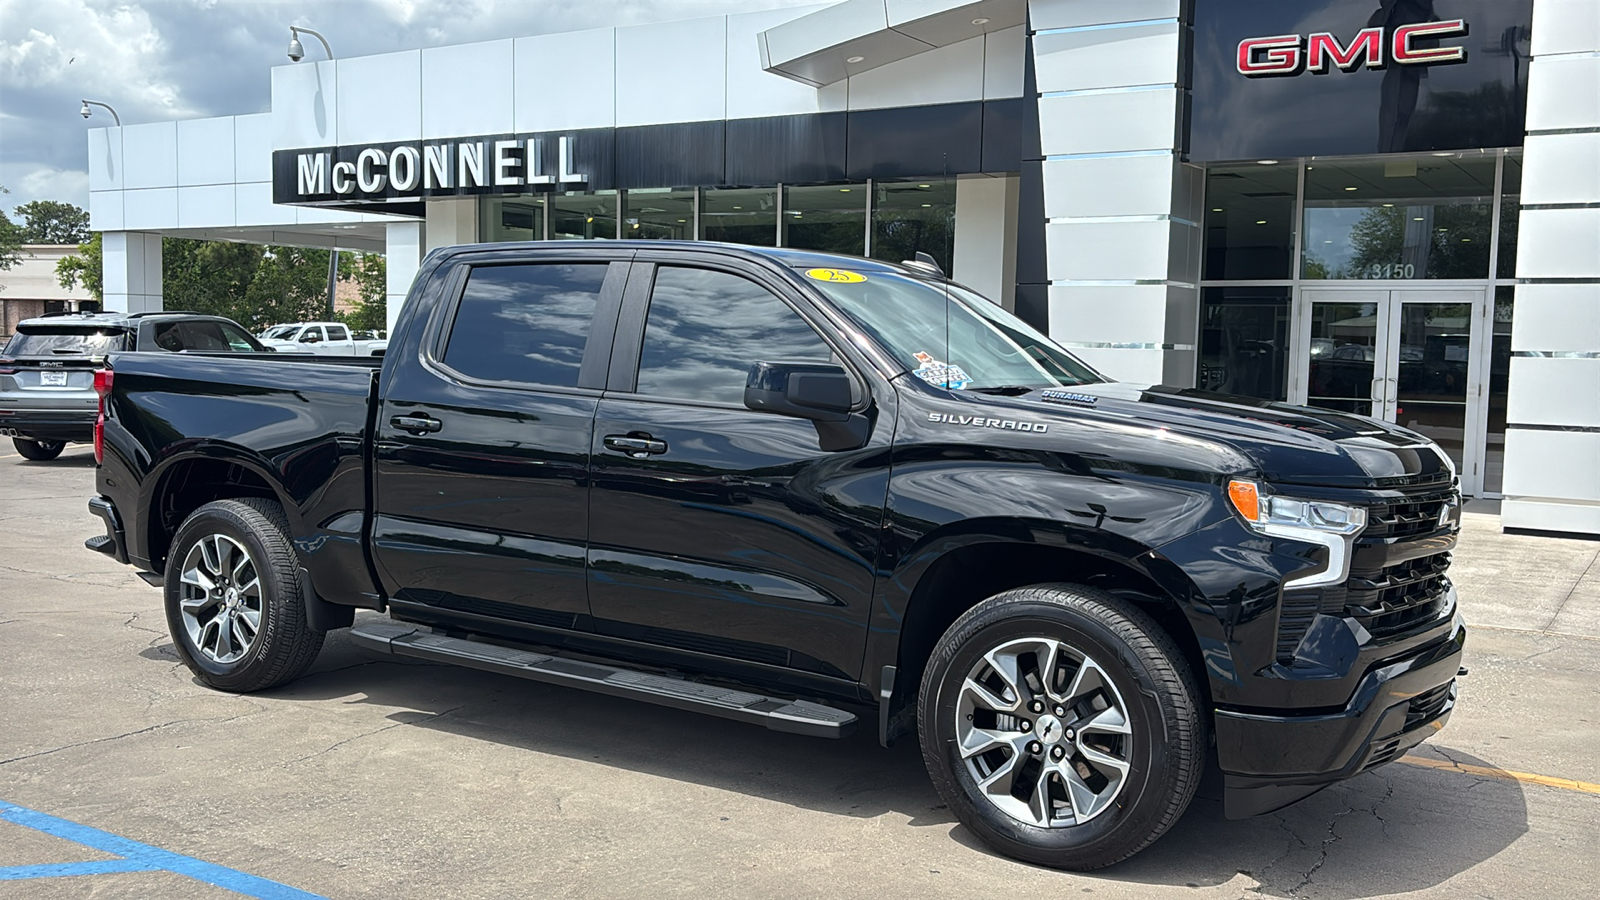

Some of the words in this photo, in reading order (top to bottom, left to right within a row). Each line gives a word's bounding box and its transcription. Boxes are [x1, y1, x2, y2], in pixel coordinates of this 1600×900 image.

[1236, 18, 1465, 76] GMC
[297, 136, 588, 196] McCONNELL
[823, 269, 850, 281] 25
[1371, 263, 1415, 279] 3150
[1041, 390, 1098, 404] DURAMAX
[927, 412, 1049, 434] SILVERADO
[257, 599, 278, 664] BRIDGESTONE
